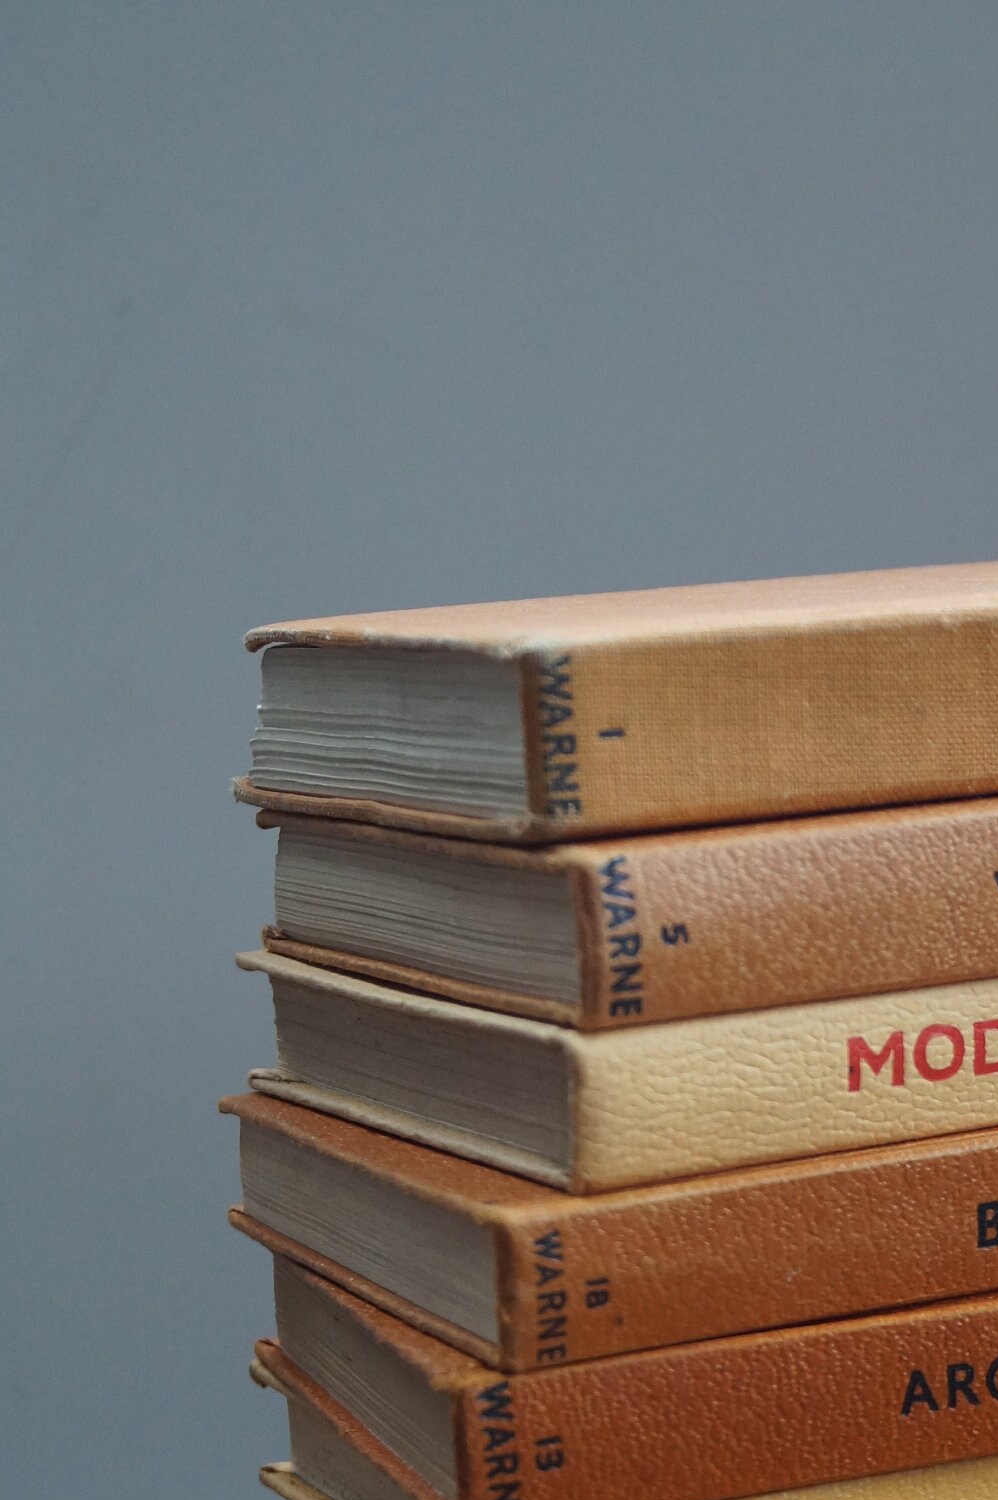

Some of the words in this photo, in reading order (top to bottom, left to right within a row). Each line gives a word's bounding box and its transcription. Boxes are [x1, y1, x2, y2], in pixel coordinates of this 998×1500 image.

[538, 654, 582, 819] WARNE
[598, 855, 643, 1018] WARNE
[661, 923, 689, 947] 5
[534, 1229, 568, 1363] WARNE
[584, 1276, 610, 1310] 18
[533, 1435, 566, 1473] 13
